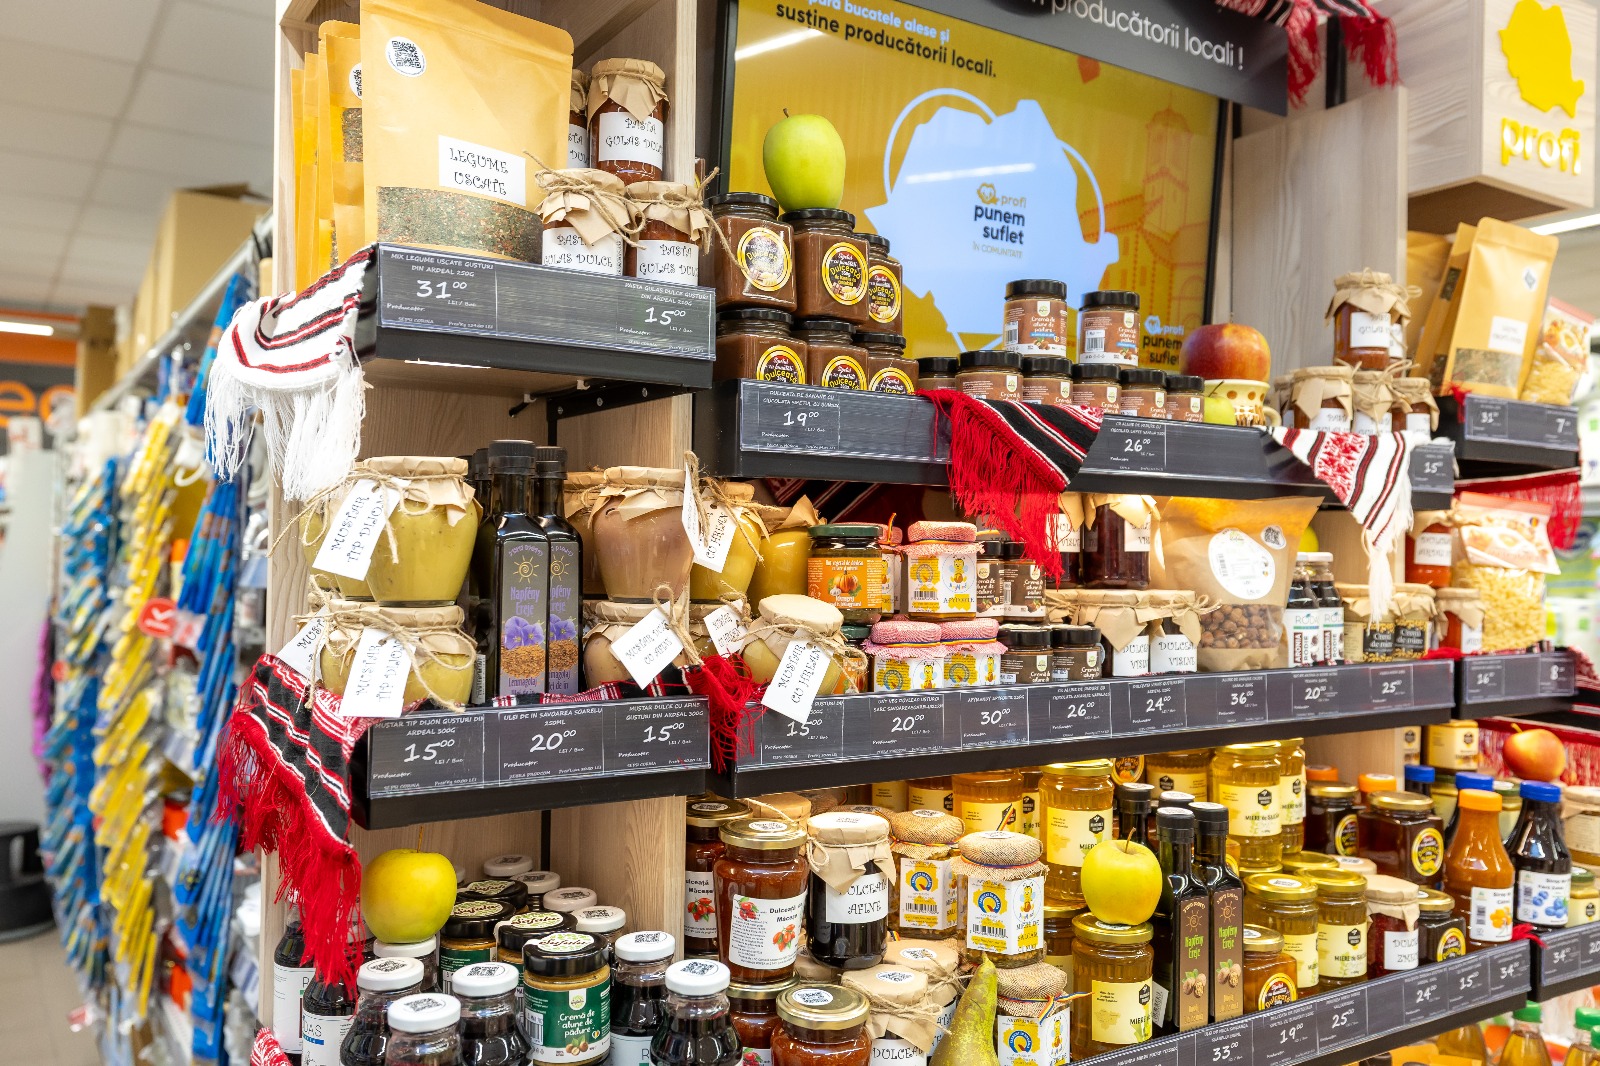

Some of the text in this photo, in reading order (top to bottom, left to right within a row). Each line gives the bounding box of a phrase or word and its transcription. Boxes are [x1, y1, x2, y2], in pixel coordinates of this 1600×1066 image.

[844, 0, 951, 45] bucatele alese și
[776, 3, 997, 78] susține producătorii locali.
[1052, 0, 1180, 49] producătorii
[1184, 27, 1235, 67] locali
[624, 117, 657, 135] PASTA
[605, 135, 640, 147] GULAS
[1501, 117, 1581, 176] profi
[449, 147, 509, 174] LEGUME
[454, 171, 507, 196] USCATE
[1001, 195, 1027, 208] profi
[974, 205, 1026, 226] punem
[983, 225, 1024, 244] suflet
[659, 243, 692, 258] PASTA
[982, 244, 1024, 259] COMUNITATE
[405, 254, 435, 263] LEGUME
[436, 258, 463, 267] USCATE
[464, 261, 494, 270] GUSTURI
[576, 255, 613, 268] DULCE
[639, 263, 676, 275] GULAS
[425, 266, 455, 275] ARDEAL
[416, 280, 452, 299] 31
[624, 282, 709, 300] PASTA GULAS DULCE GUSTURI
[652, 295, 676, 304] ARDEAL
[644, 306, 675, 325] 15
[1163, 325, 1185, 336] profi
[1143, 336, 1183, 350] punem
[783, 410, 808, 427] 19
[1555, 418, 1566, 433] 7
[1124, 438, 1143, 452] 26
[1423, 461, 1438, 474] 15
[330, 496, 370, 551] MUSTAR
[346, 540, 365, 563] TIP
[510, 585, 541, 604] Napfény
[550, 585, 572, 603] pfény
[515, 603, 535, 617] Ereje
[1294, 633, 1302, 662] ARONIA
[778, 644, 806, 689] MUSTAR
[798, 645, 821, 688] HREAN
[1304, 686, 1321, 701] 20
[1381, 681, 1397, 695] 25
[628, 704, 653, 712] MUSTAR
[653, 703, 674, 711] DULCE
[684, 701, 701, 709] AFINE
[1145, 697, 1164, 713] 24
[1230, 692, 1248, 706] 36
[503, 713, 519, 721] ULEI
[519, 713, 529, 721] DE
[539, 710, 573, 719] SAVOAREA
[625, 712, 651, 721] GUSTURI
[663, 710, 688, 718] ARDEAL
[980, 710, 1002, 726] 30
[1067, 703, 1087, 719] 26
[375, 720, 404, 729] MUSTAR
[419, 718, 441, 726] DIJON
[442, 716, 472, 725] GUSTURI
[543, 719, 566, 727] 250ML
[786, 720, 813, 737] 15
[891, 716, 915, 733] 20
[406, 728, 436, 737] ARDEAL
[642, 725, 673, 744] 15
[529, 732, 564, 753] 20
[403, 742, 441, 763] 15
[847, 900, 881, 915] AFINE
[1218, 926, 1238, 938] Napfény
[1184, 935, 1204, 948] Napfény
[1499, 964, 1514, 979] 34
[1459, 975, 1473, 992] 15
[1415, 988, 1431, 1004] 24
[559, 1008, 596, 1021] Cremă de
[1331, 1011, 1349, 1029] 25
[562, 1017, 594, 1029] alune de
[564, 1027, 591, 1039] pădure
[1279, 1026, 1296, 1045] 19
[1212, 1045, 1230, 1062] 33
